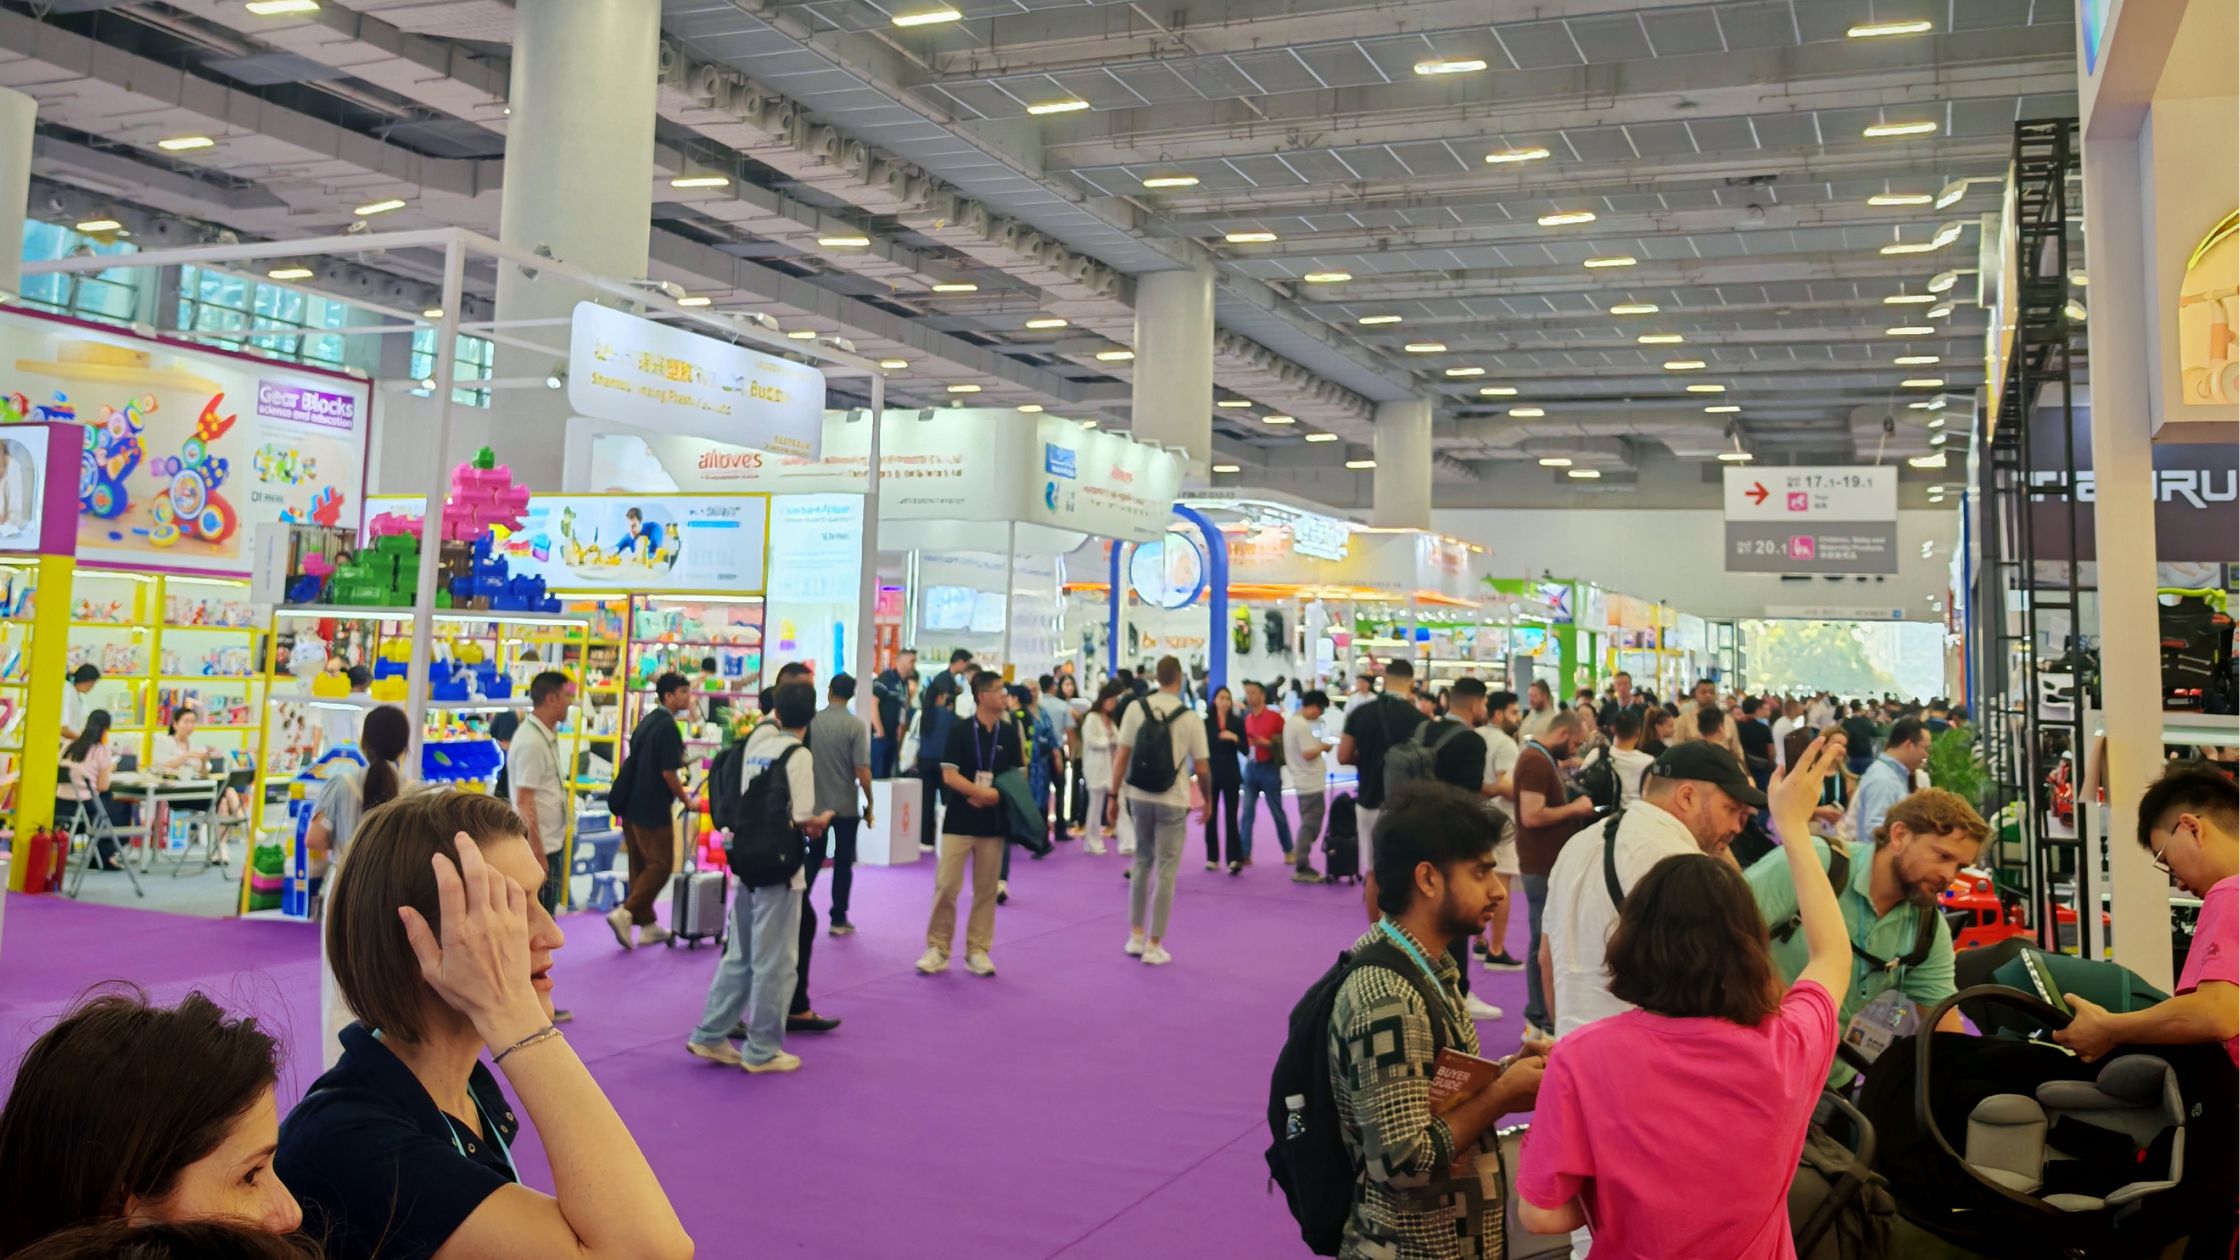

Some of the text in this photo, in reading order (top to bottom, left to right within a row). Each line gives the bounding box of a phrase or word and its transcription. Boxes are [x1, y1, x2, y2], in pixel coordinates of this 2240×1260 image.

[260, 385, 354, 418] Gear Blocks
[1806, 475, 1873, 489] 17.1-19.1
[1755, 539, 1788, 555] 20.1
[1436, 1065, 1472, 1082] BUYER
[1432, 1076, 1465, 1092] GUIDE
